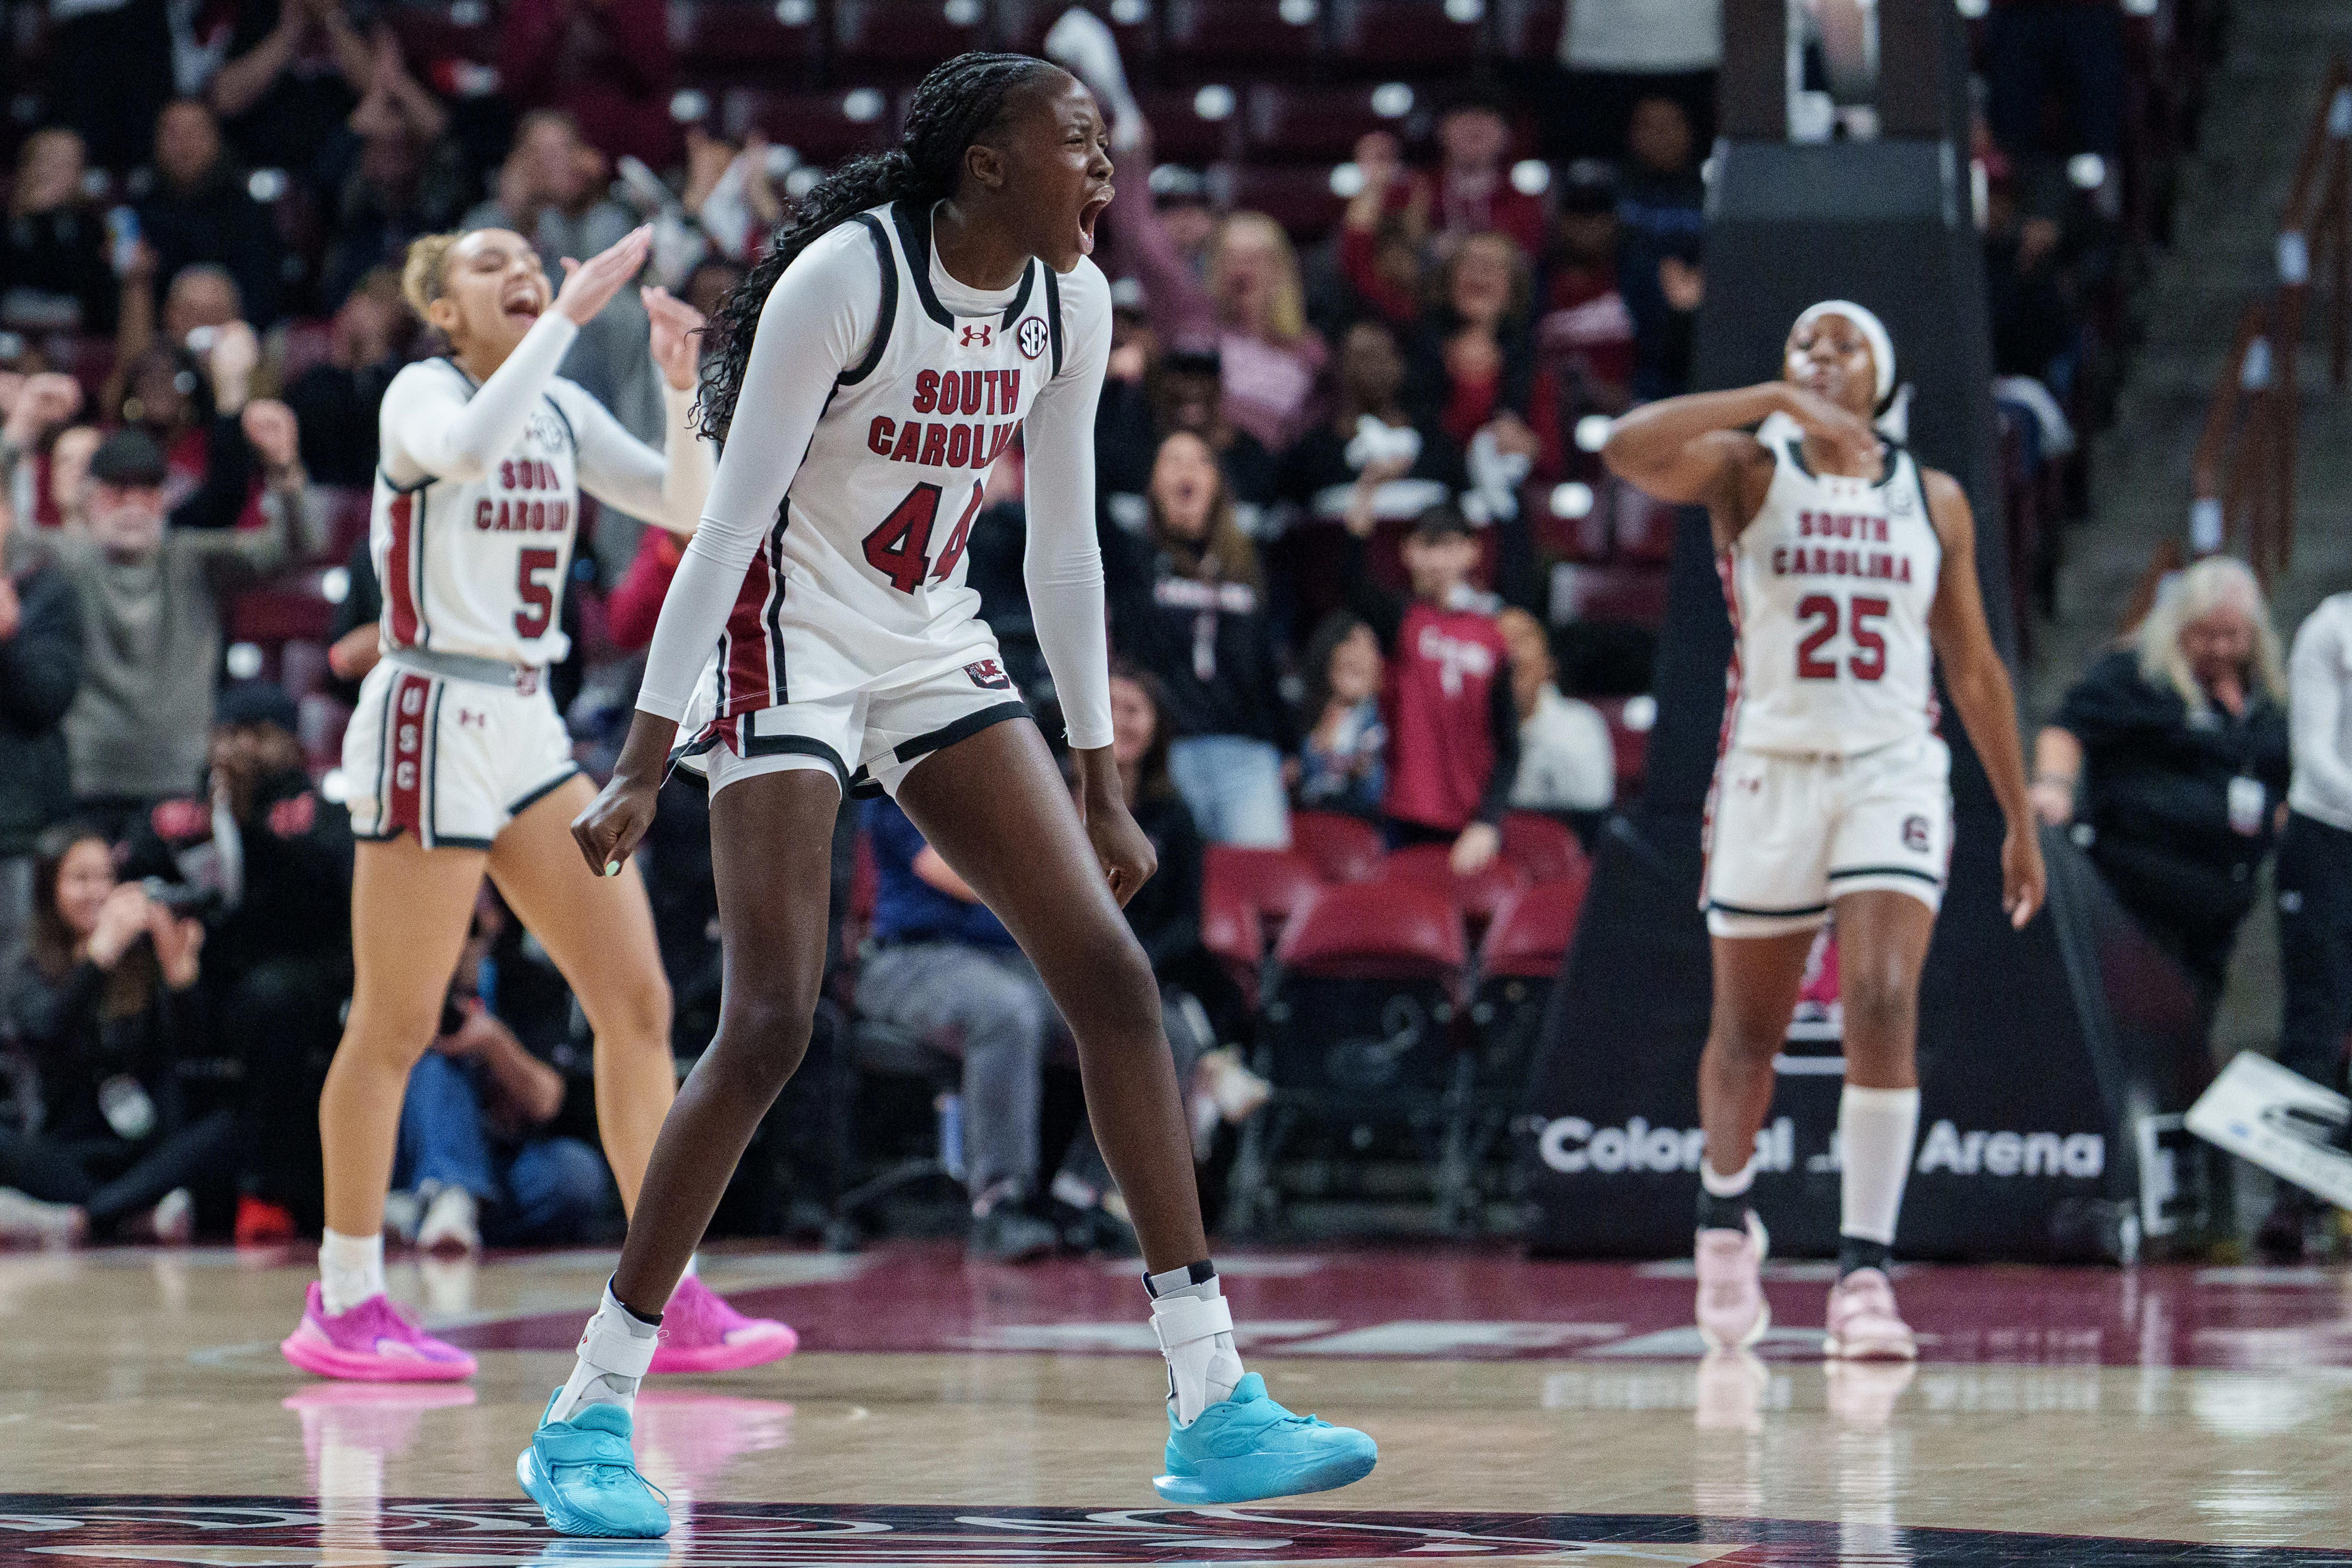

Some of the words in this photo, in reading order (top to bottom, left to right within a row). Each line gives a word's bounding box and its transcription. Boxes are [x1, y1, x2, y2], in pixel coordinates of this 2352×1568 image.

[1019, 319, 1047, 357] SEC
[913, 369, 1021, 415] SOUTH
[861, 478, 984, 596] 44
[1798, 509, 1890, 542] SOUTH
[514, 547, 558, 639] 5
[1771, 543, 1911, 584] CAROLINA
[1796, 593, 1890, 681] 25
[395, 686, 424, 790] USC
[1539, 1116, 1794, 1173] Colonl
[1916, 1118, 2105, 1177] Arena
